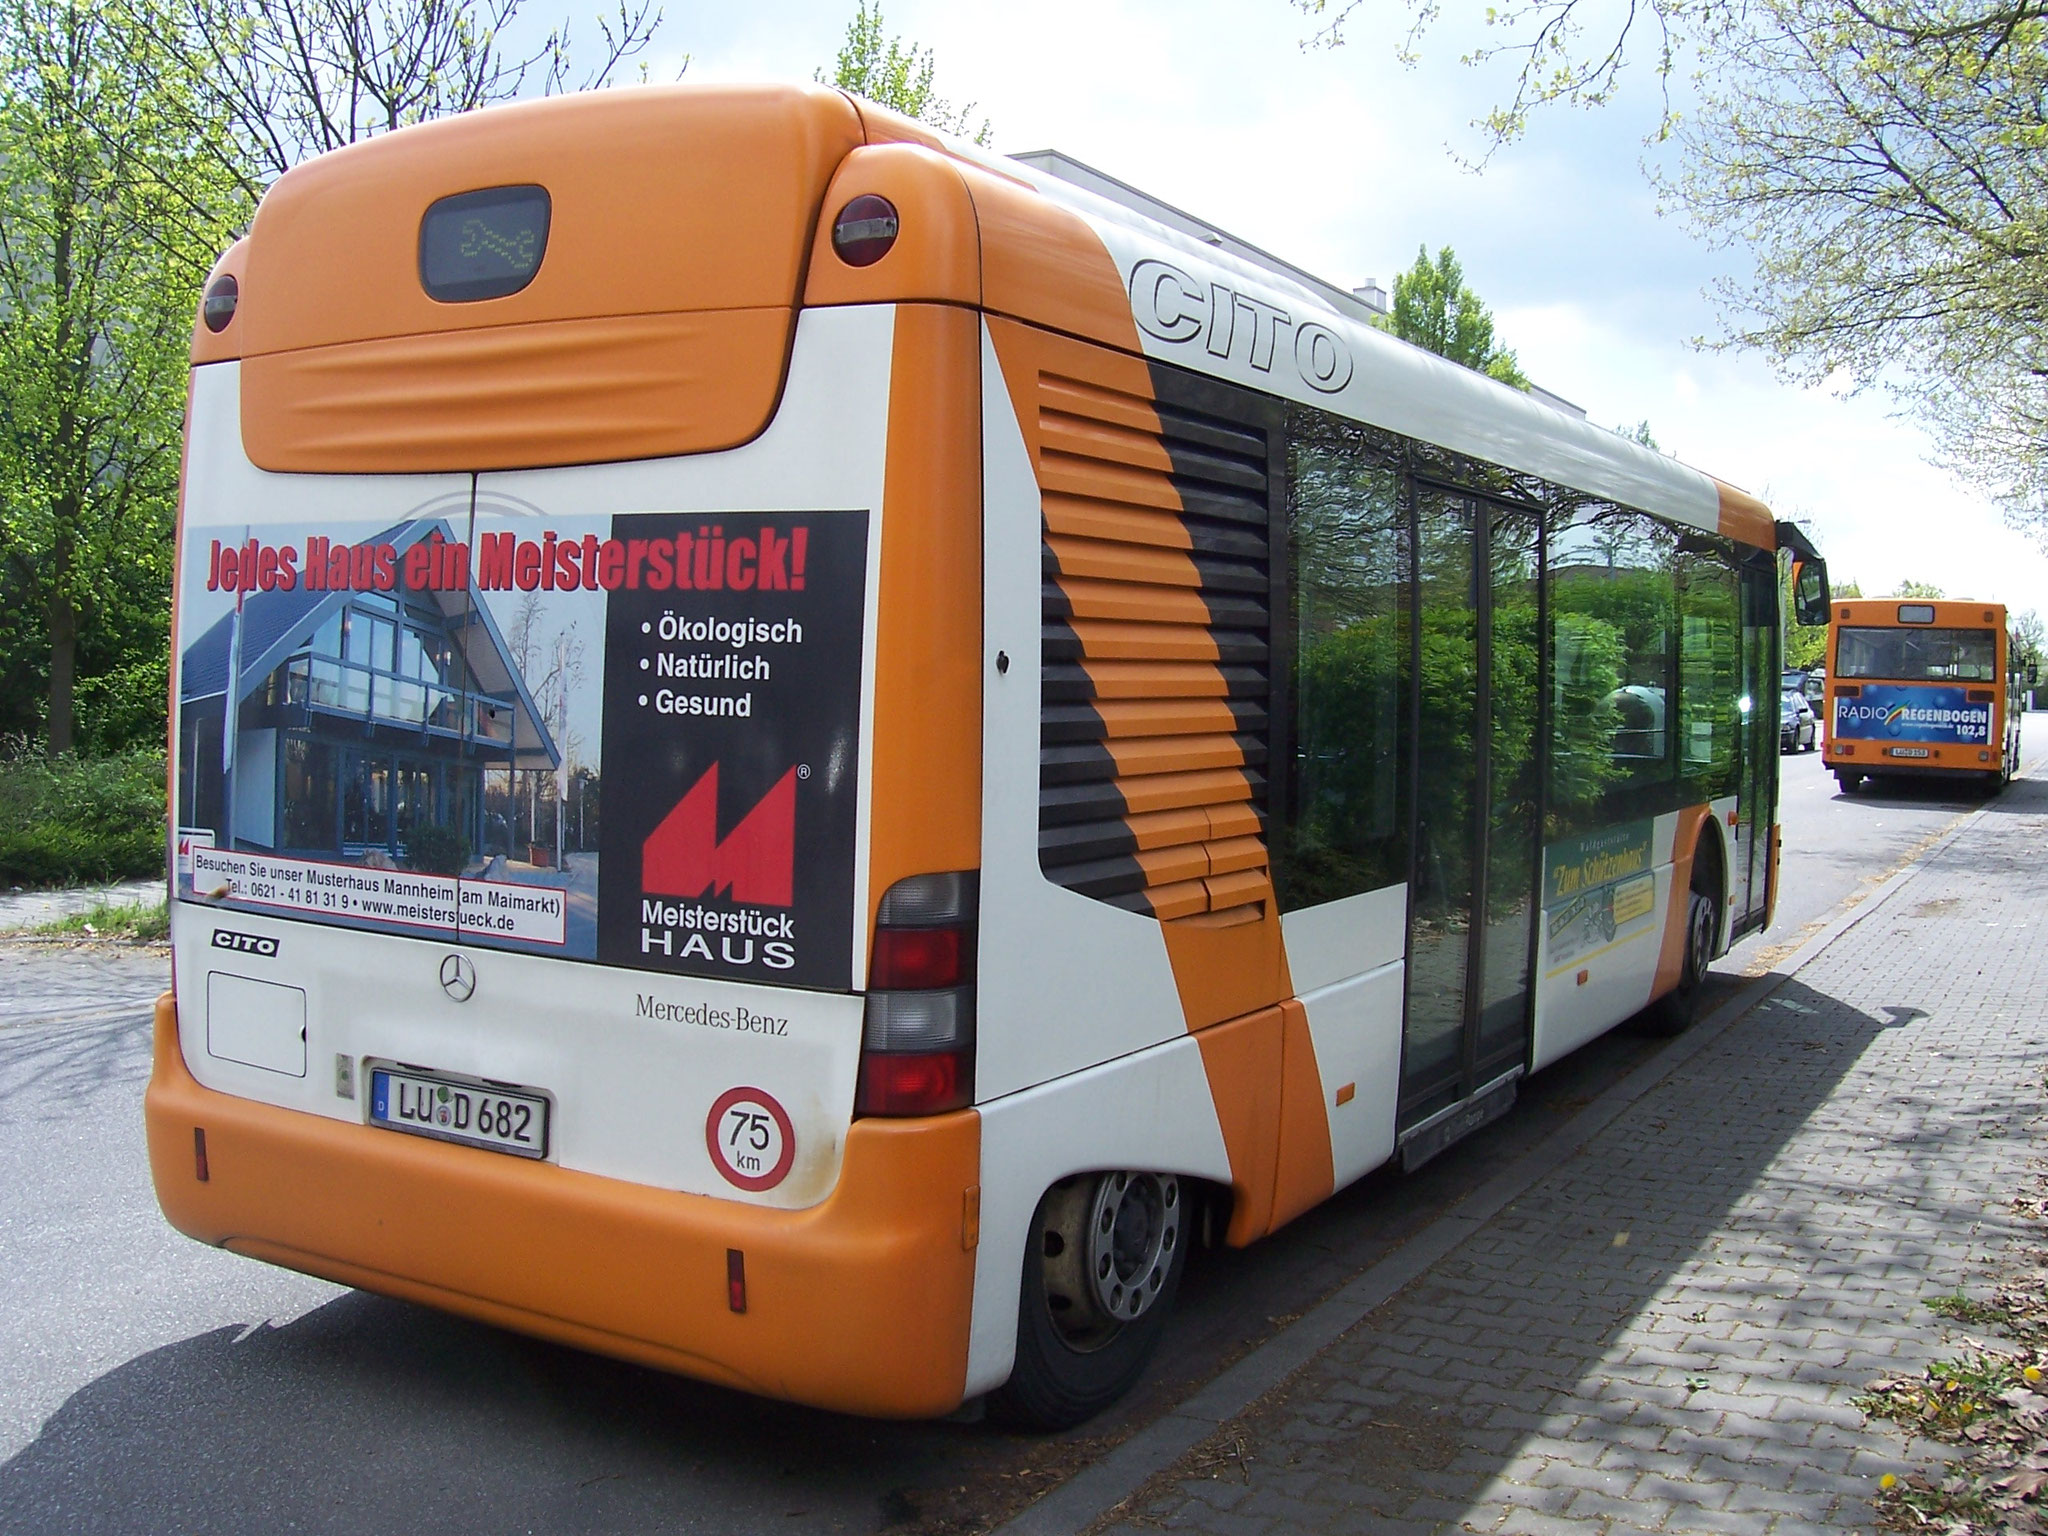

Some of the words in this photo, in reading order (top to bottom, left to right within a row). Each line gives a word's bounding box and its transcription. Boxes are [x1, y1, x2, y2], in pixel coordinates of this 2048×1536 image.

[1129, 258, 1354, 394] CITO
[206, 537, 298, 593] Jedes
[303, 535, 397, 593] Haus
[404, 532, 469, 592] ein
[478, 524, 809, 592] Meisterstück!
[658, 610, 803, 648] Ökologisch
[656, 652, 771, 681] Natürlich
[655, 688, 752, 718] Gesund
[1838, 705, 1889, 720] RADIO
[1901, 708, 1987, 724] REGENBOGEN
[1956, 725, 1986, 738] 102,8
[195, 855, 246, 875] Besuchen
[249, 861, 267, 878] Sie
[270, 867, 303, 883] unser
[306, 869, 379, 893] Musterhaus
[384, 878, 454, 901] Mannheim
[488, 891, 561, 918] Maimarkt)
[226, 878, 248, 896] Tel.:
[251, 882, 276, 899] 0621
[288, 887, 300, 902] 41
[306, 889, 318, 905] 81
[323, 892, 336, 907] 31
[341, 894, 349, 909] 9
[362, 899, 515, 931] www.meistersueck.de
[641, 899, 795, 939] Meisterstück
[214, 931, 276, 955] CITO
[641, 928, 796, 969] HAUS
[635, 993, 789, 1037] Mercedes-Benz
[400, 1082, 434, 1124] LU
[478, 1098, 531, 1143] 682
[729, 1110, 770, 1151] 75
[736, 1150, 761, 1172] km
